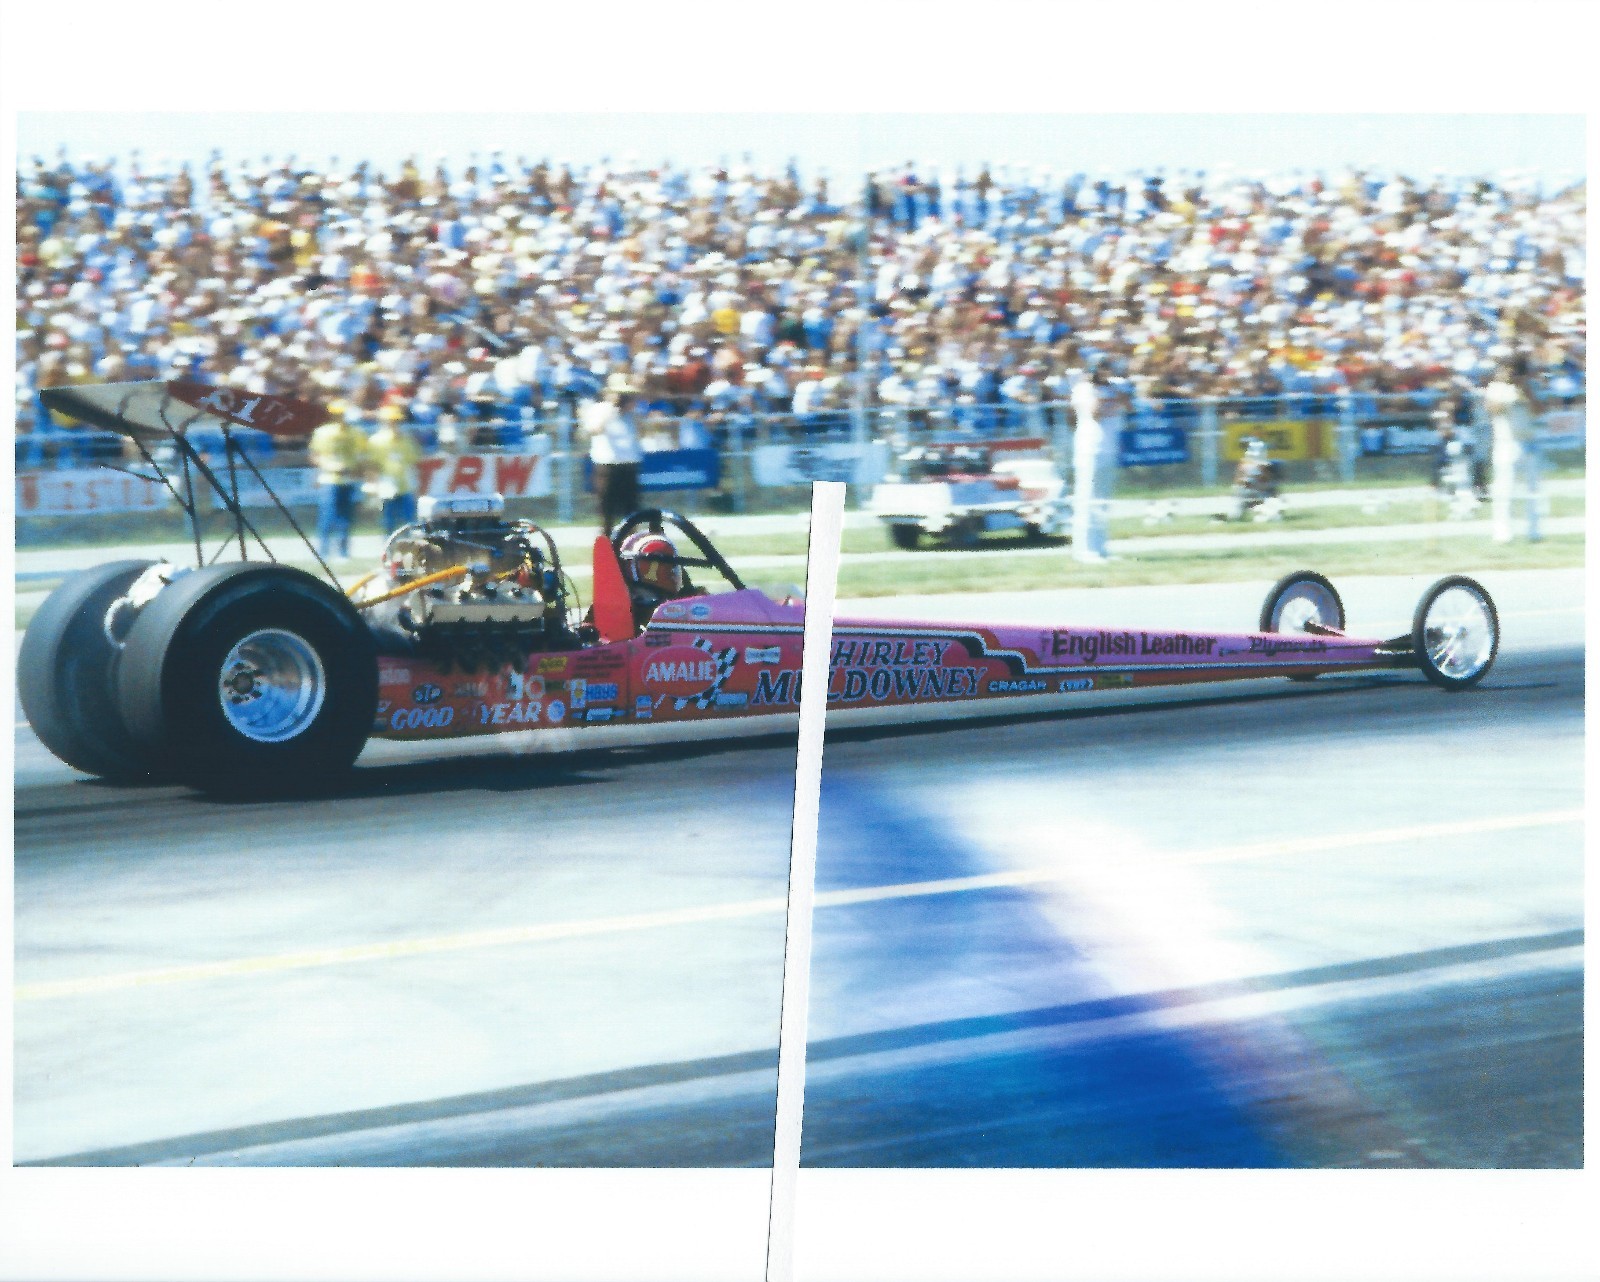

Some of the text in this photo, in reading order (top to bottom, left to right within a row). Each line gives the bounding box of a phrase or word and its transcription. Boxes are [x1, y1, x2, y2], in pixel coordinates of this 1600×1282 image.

[415, 454, 541, 495] TRW
[831, 640, 950, 668] HIRLEY
[1051, 629, 1136, 662] English
[1140, 633, 1218, 656] Leather
[646, 660, 716, 683] AMALIE
[390, 705, 455, 731] GOOD
[479, 700, 542, 725] YEAR
